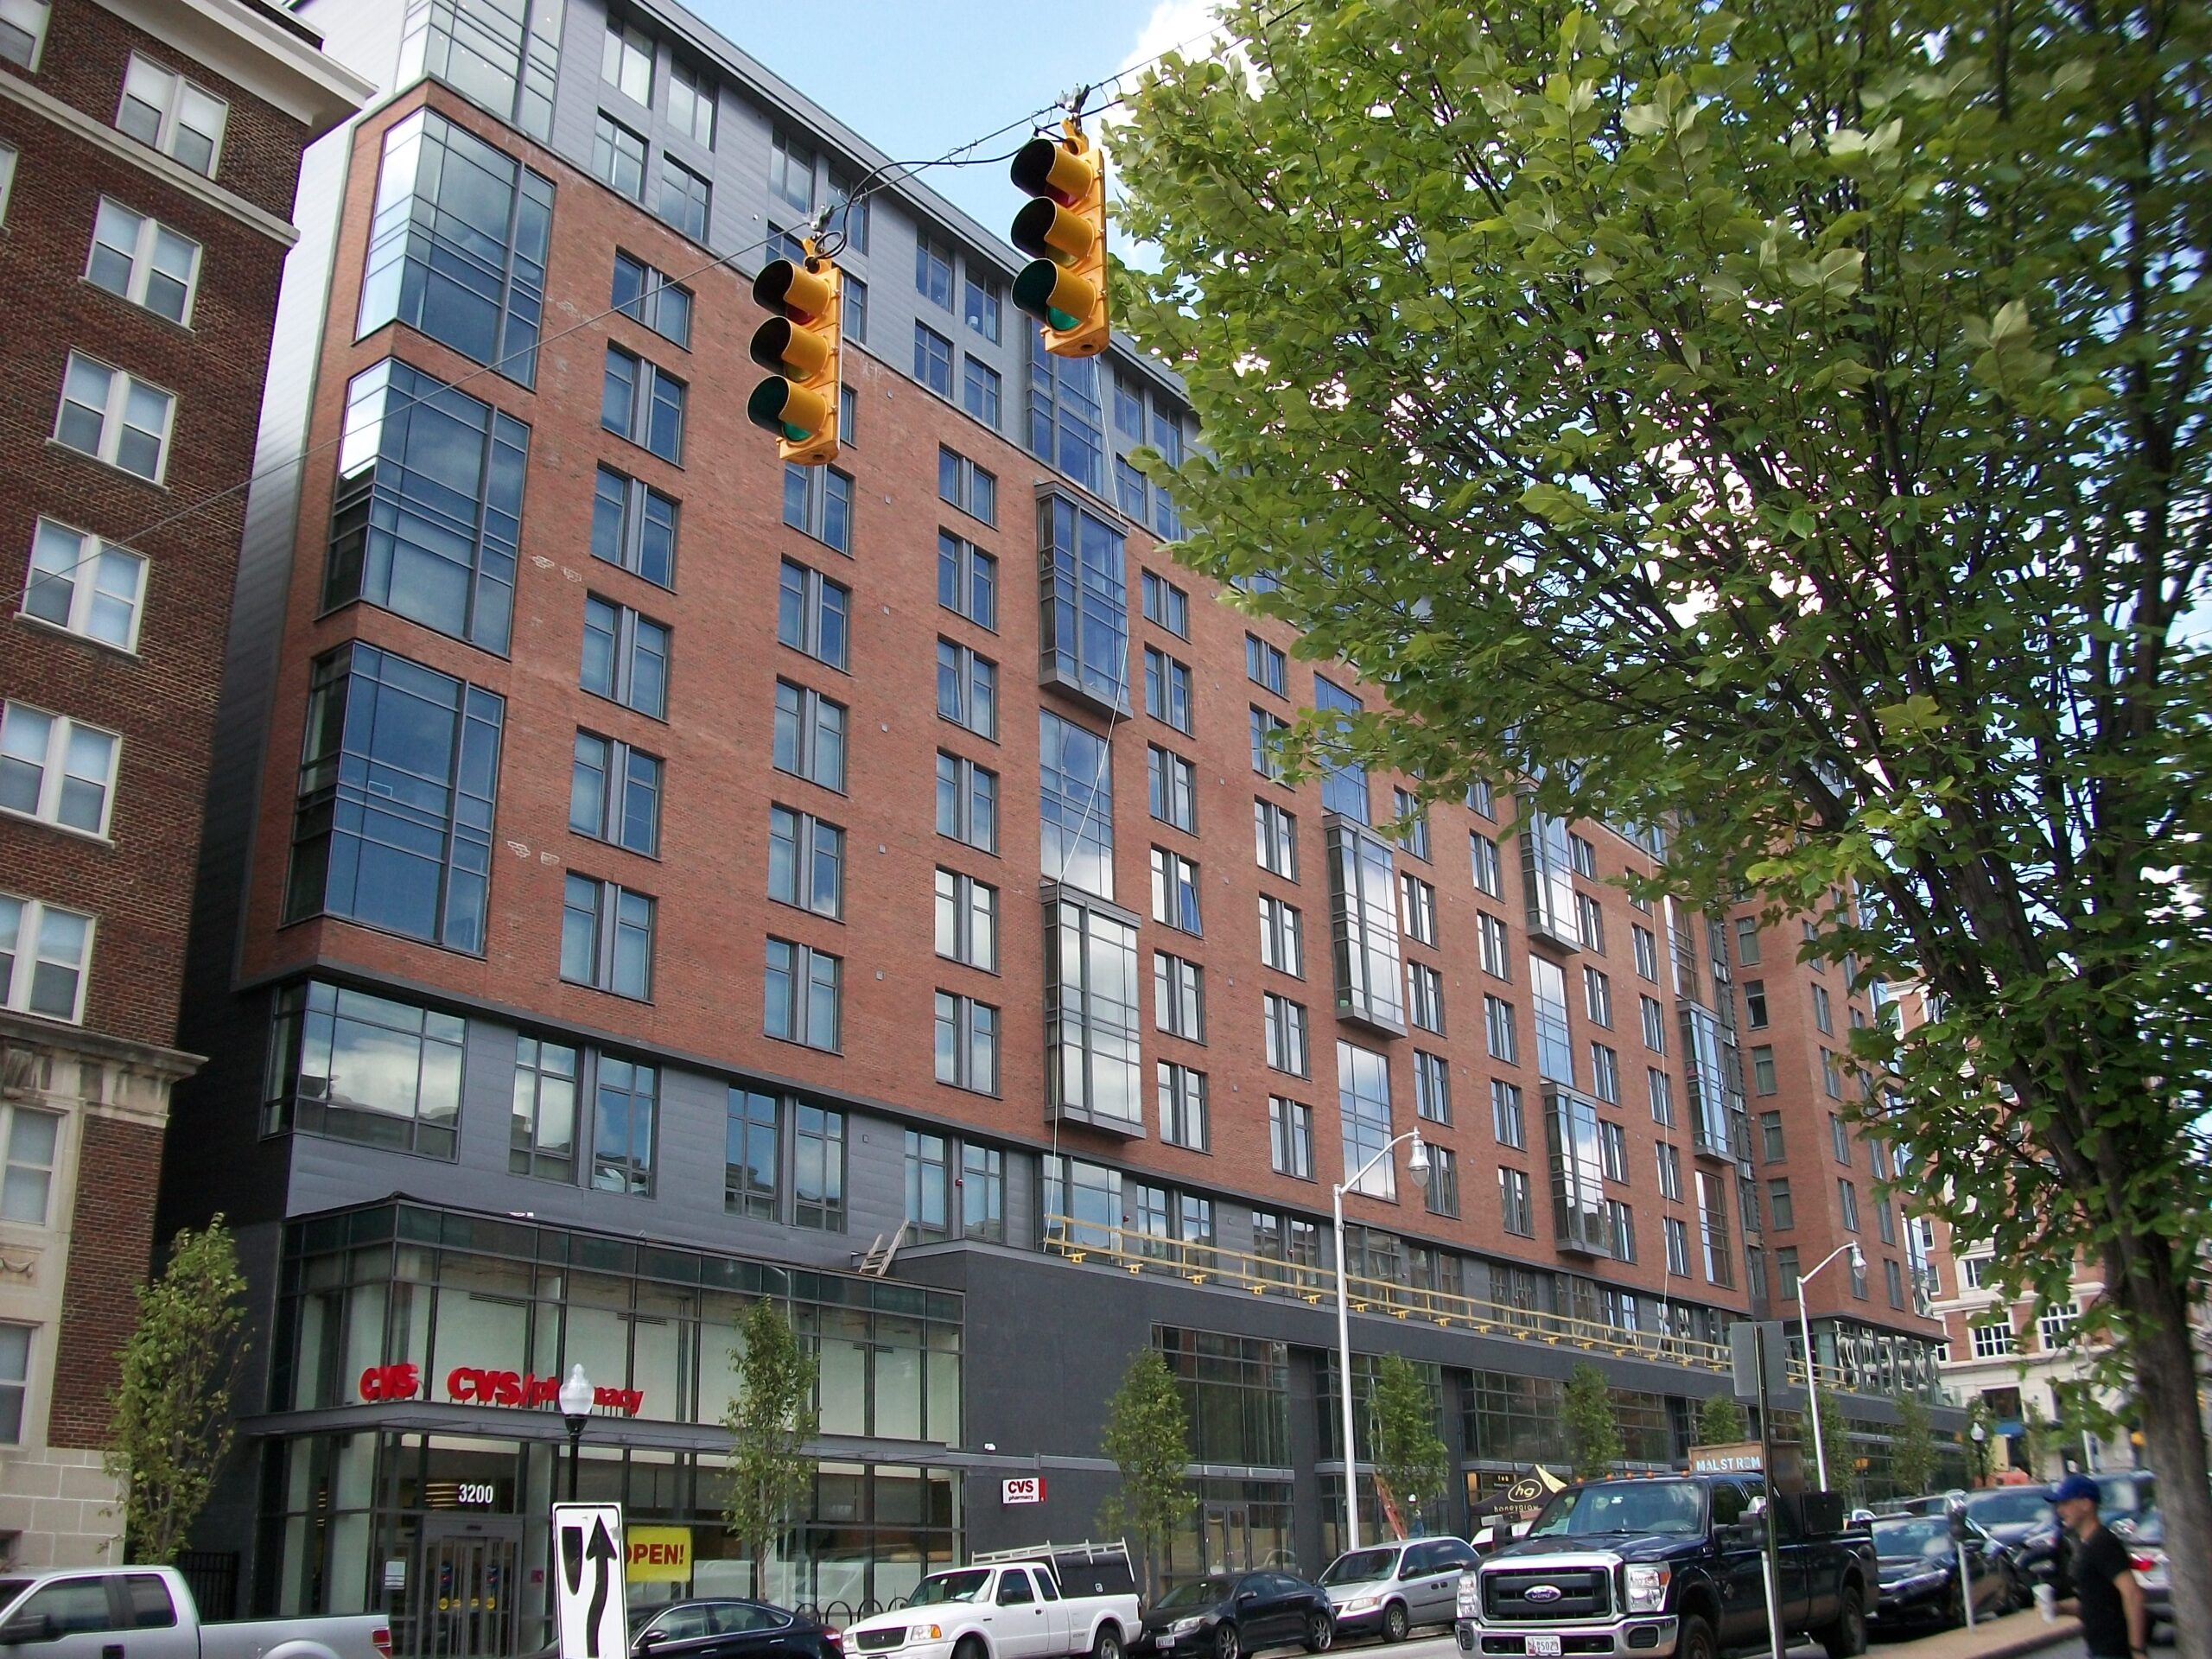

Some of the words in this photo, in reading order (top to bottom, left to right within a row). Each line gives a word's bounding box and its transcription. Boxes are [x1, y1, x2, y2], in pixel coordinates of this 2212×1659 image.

[359, 1363, 419, 1401] CVS
[458, 1484, 493, 1503] 3200
[1007, 1479, 1034, 1494] CVS
[1515, 1484, 1535, 1498] hg
